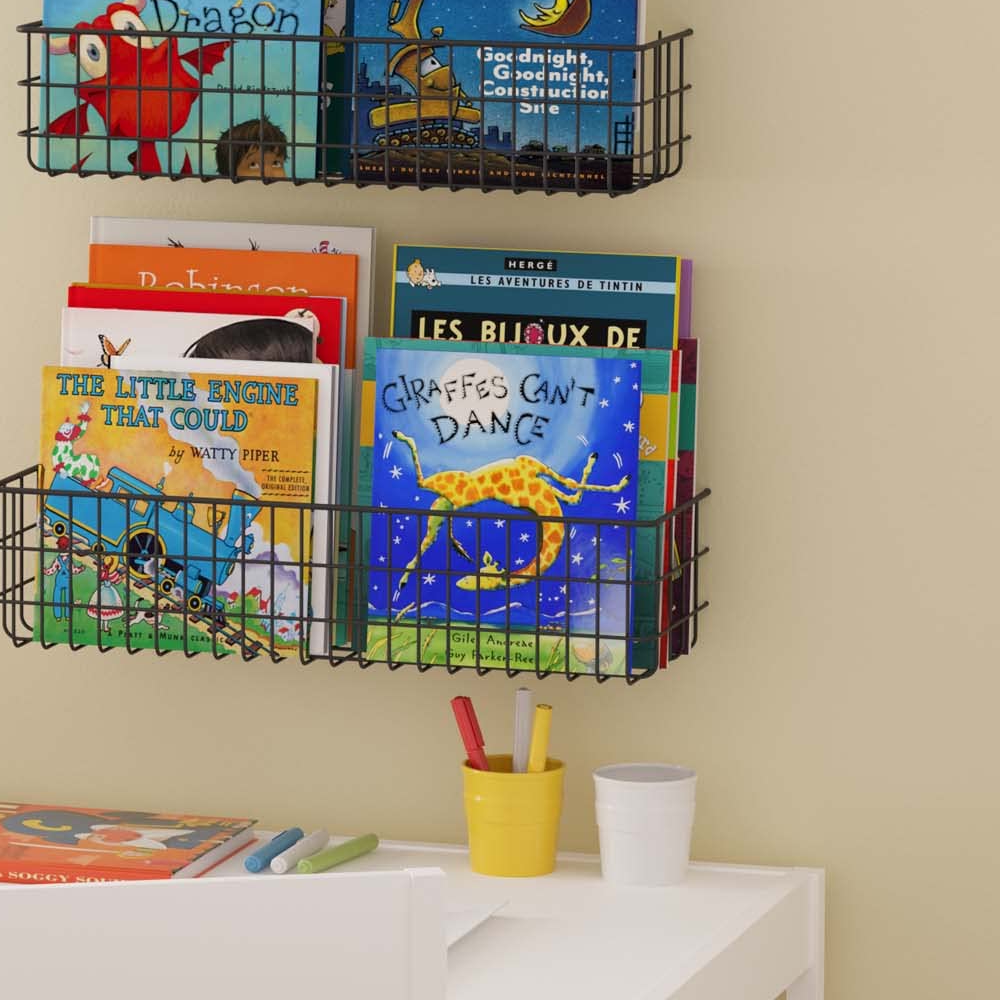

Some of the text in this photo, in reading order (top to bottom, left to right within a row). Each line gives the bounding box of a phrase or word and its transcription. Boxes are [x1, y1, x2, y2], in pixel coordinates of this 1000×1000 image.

[508, 260, 553, 270] HERGÉ
[470, 275, 643, 292] LES AVENTURES DE TINTIN
[419, 317, 463, 341] LES
[608, 326, 641, 349] DE
[57, 373, 299, 406] THE LITTLE ENGINE
[382, 373, 595, 413] GIRAFFES CAN'T
[101, 404, 249, 433] THAT COULD
[430, 410, 550, 445] DANCE
[169, 445, 280, 464] by WATTY PIPER
[8, 871, 69, 883] SOGGY
